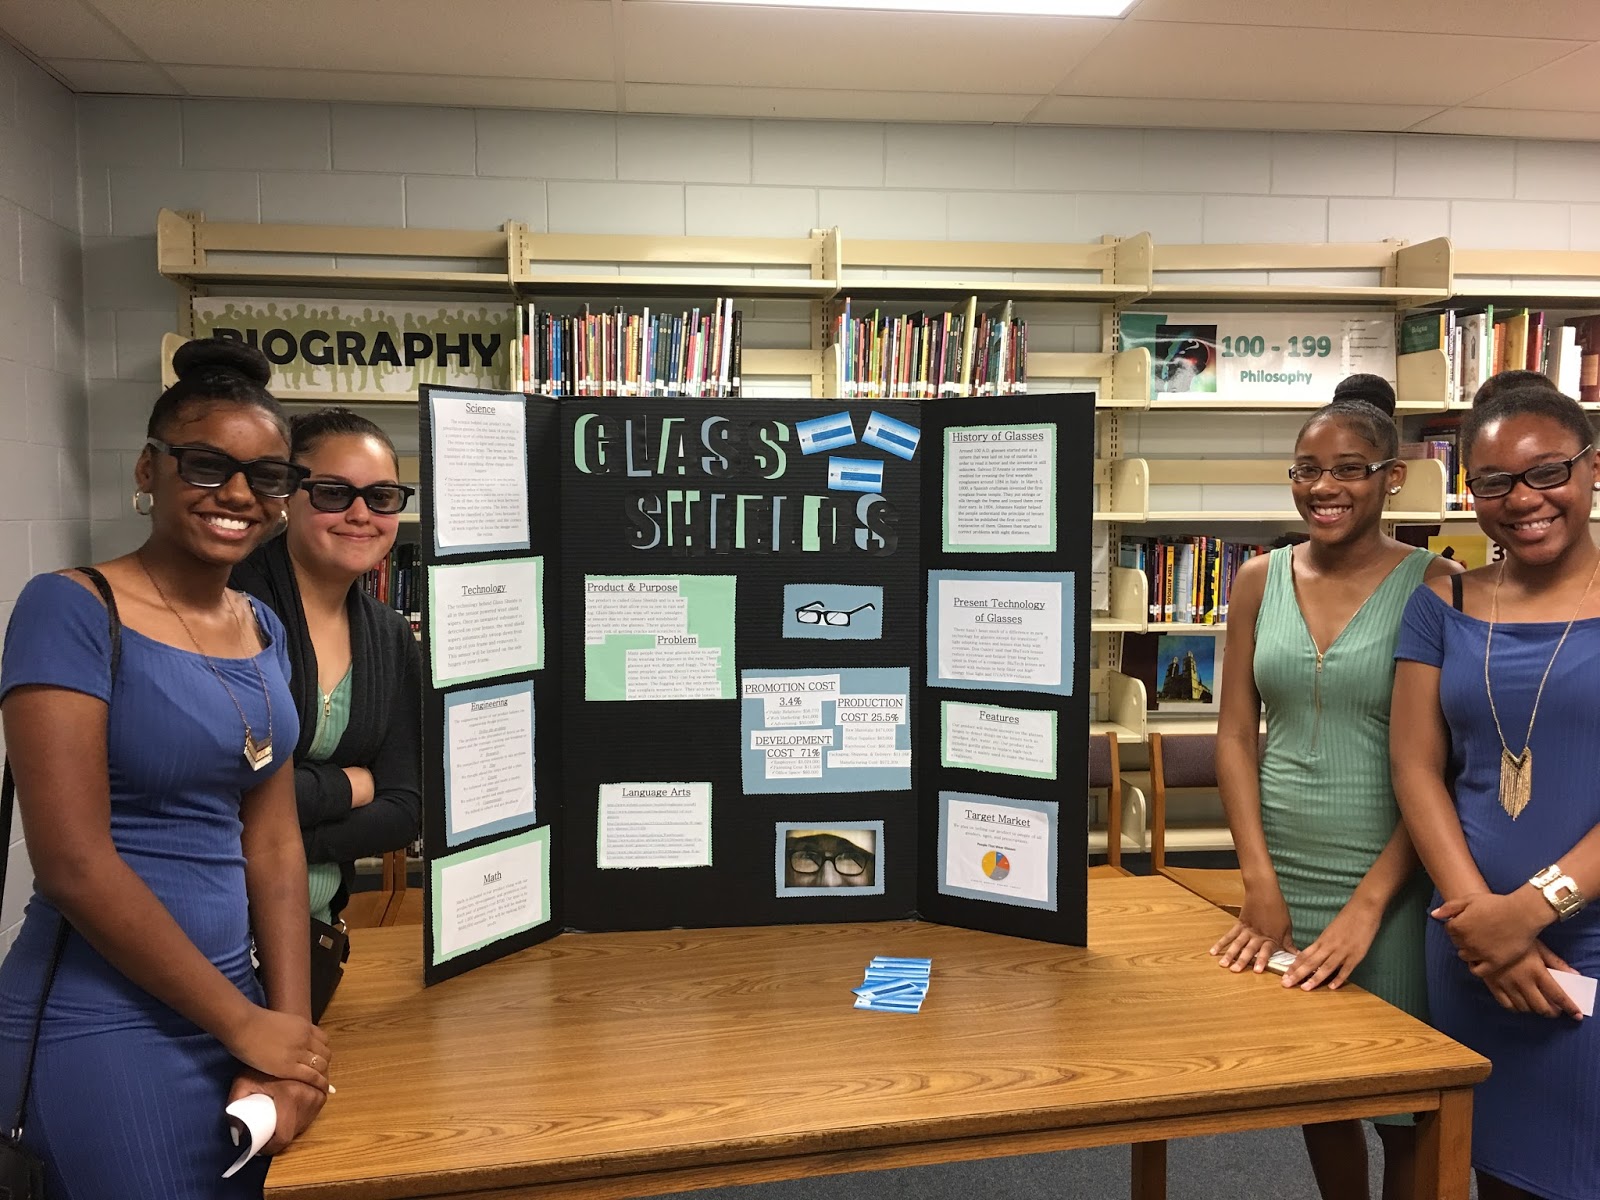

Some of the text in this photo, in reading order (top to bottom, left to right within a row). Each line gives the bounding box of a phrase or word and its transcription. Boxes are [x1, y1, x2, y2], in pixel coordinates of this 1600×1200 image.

[1221, 335, 1265, 358] 100
[1288, 335, 1332, 358] 199
[1240, 370, 1312, 385] Philosophy
[466, 402, 496, 414] Science
[952, 430, 1044, 442] History of Glasses
[574, 413, 790, 479] GLASS
[462, 584, 507, 595] Technology
[587, 582, 678, 593] Product & Purpose
[954, 597, 1046, 610] Present Technology
[975, 613, 1022, 624] of Glasses
[657, 636, 697, 644] Problem
[745, 681, 836, 693] PROMOTION COST
[471, 698, 508, 710] Engineering
[779, 697, 802, 706] 3.4%
[837, 698, 903, 707] PRODUCTION
[841, 713, 899, 722] COST 25.5%
[979, 710, 1020, 724] Features
[755, 735, 832, 746] DEVELOPMENT
[767, 749, 820, 758] COST 71%
[622, 788, 691, 797] Language Arts
[965, 810, 1031, 827] Target Market
[483, 870, 502, 884] Math
